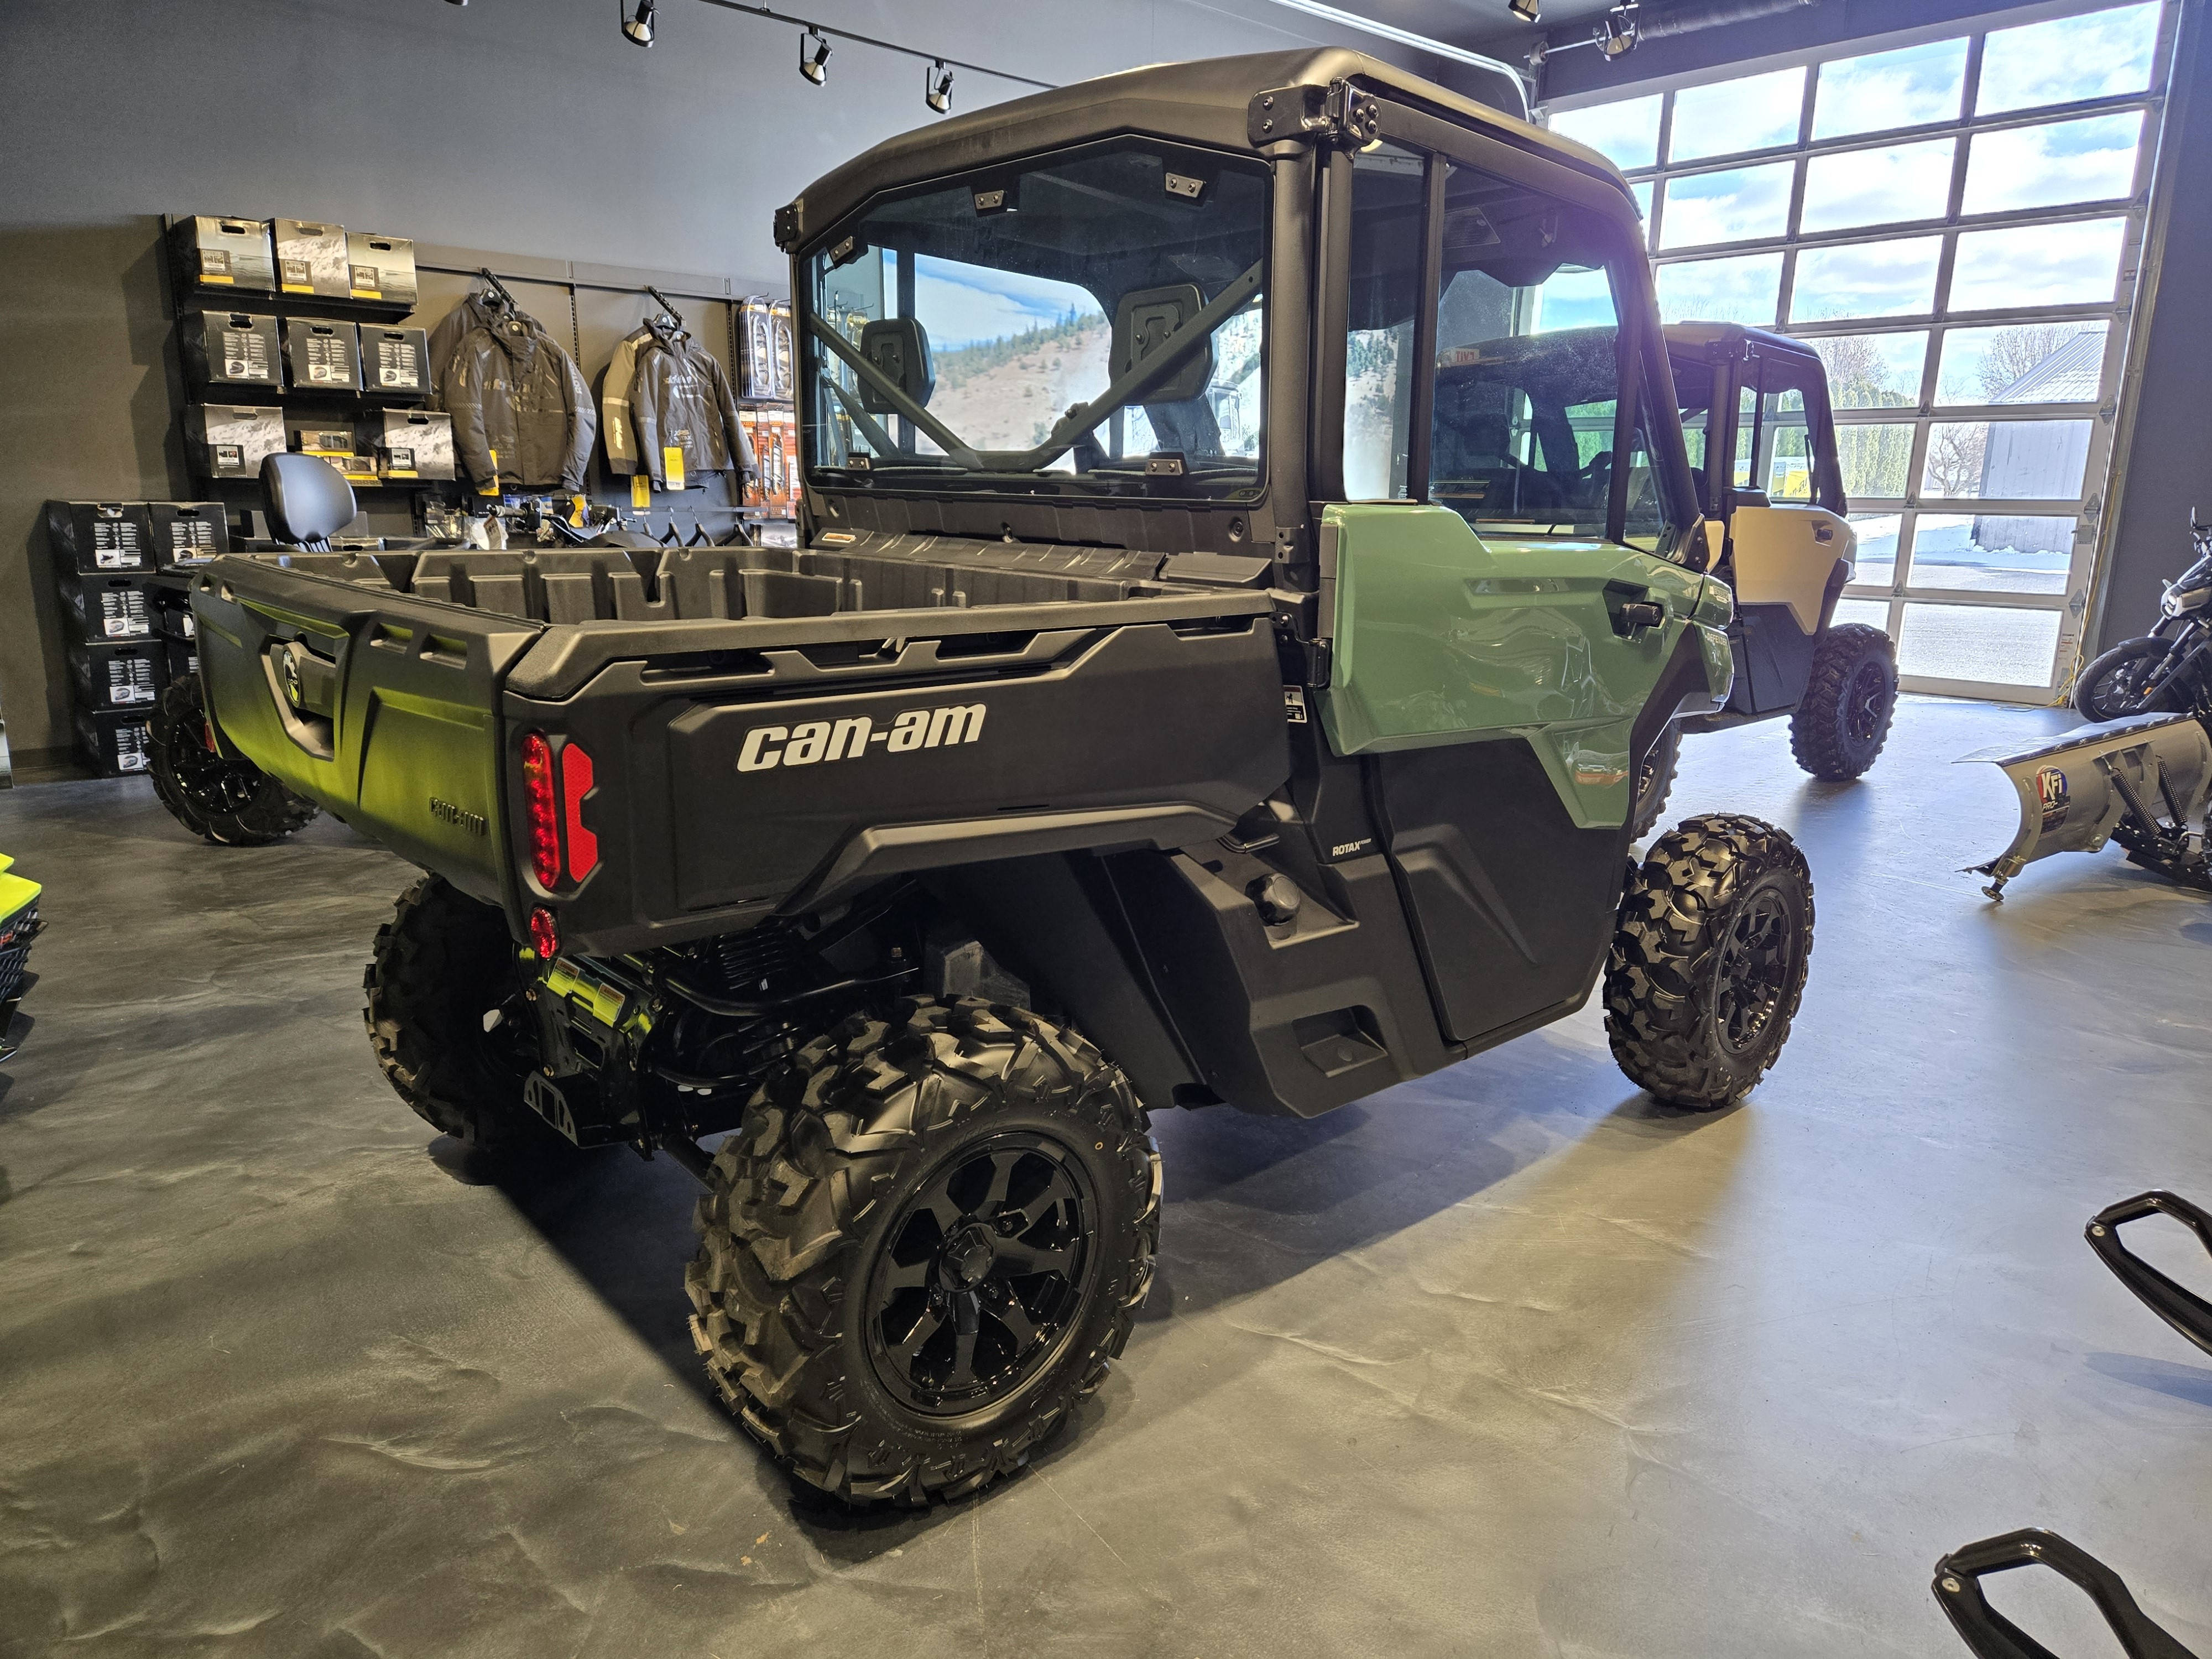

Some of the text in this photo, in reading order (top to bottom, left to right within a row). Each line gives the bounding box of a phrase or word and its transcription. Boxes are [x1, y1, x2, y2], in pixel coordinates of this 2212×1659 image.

[1706, 632, 1728, 646] DEFENDER
[737, 702, 987, 773] can-am
[429, 797, 484, 836] can-am
[1332, 840, 1360, 857] ROTAX
